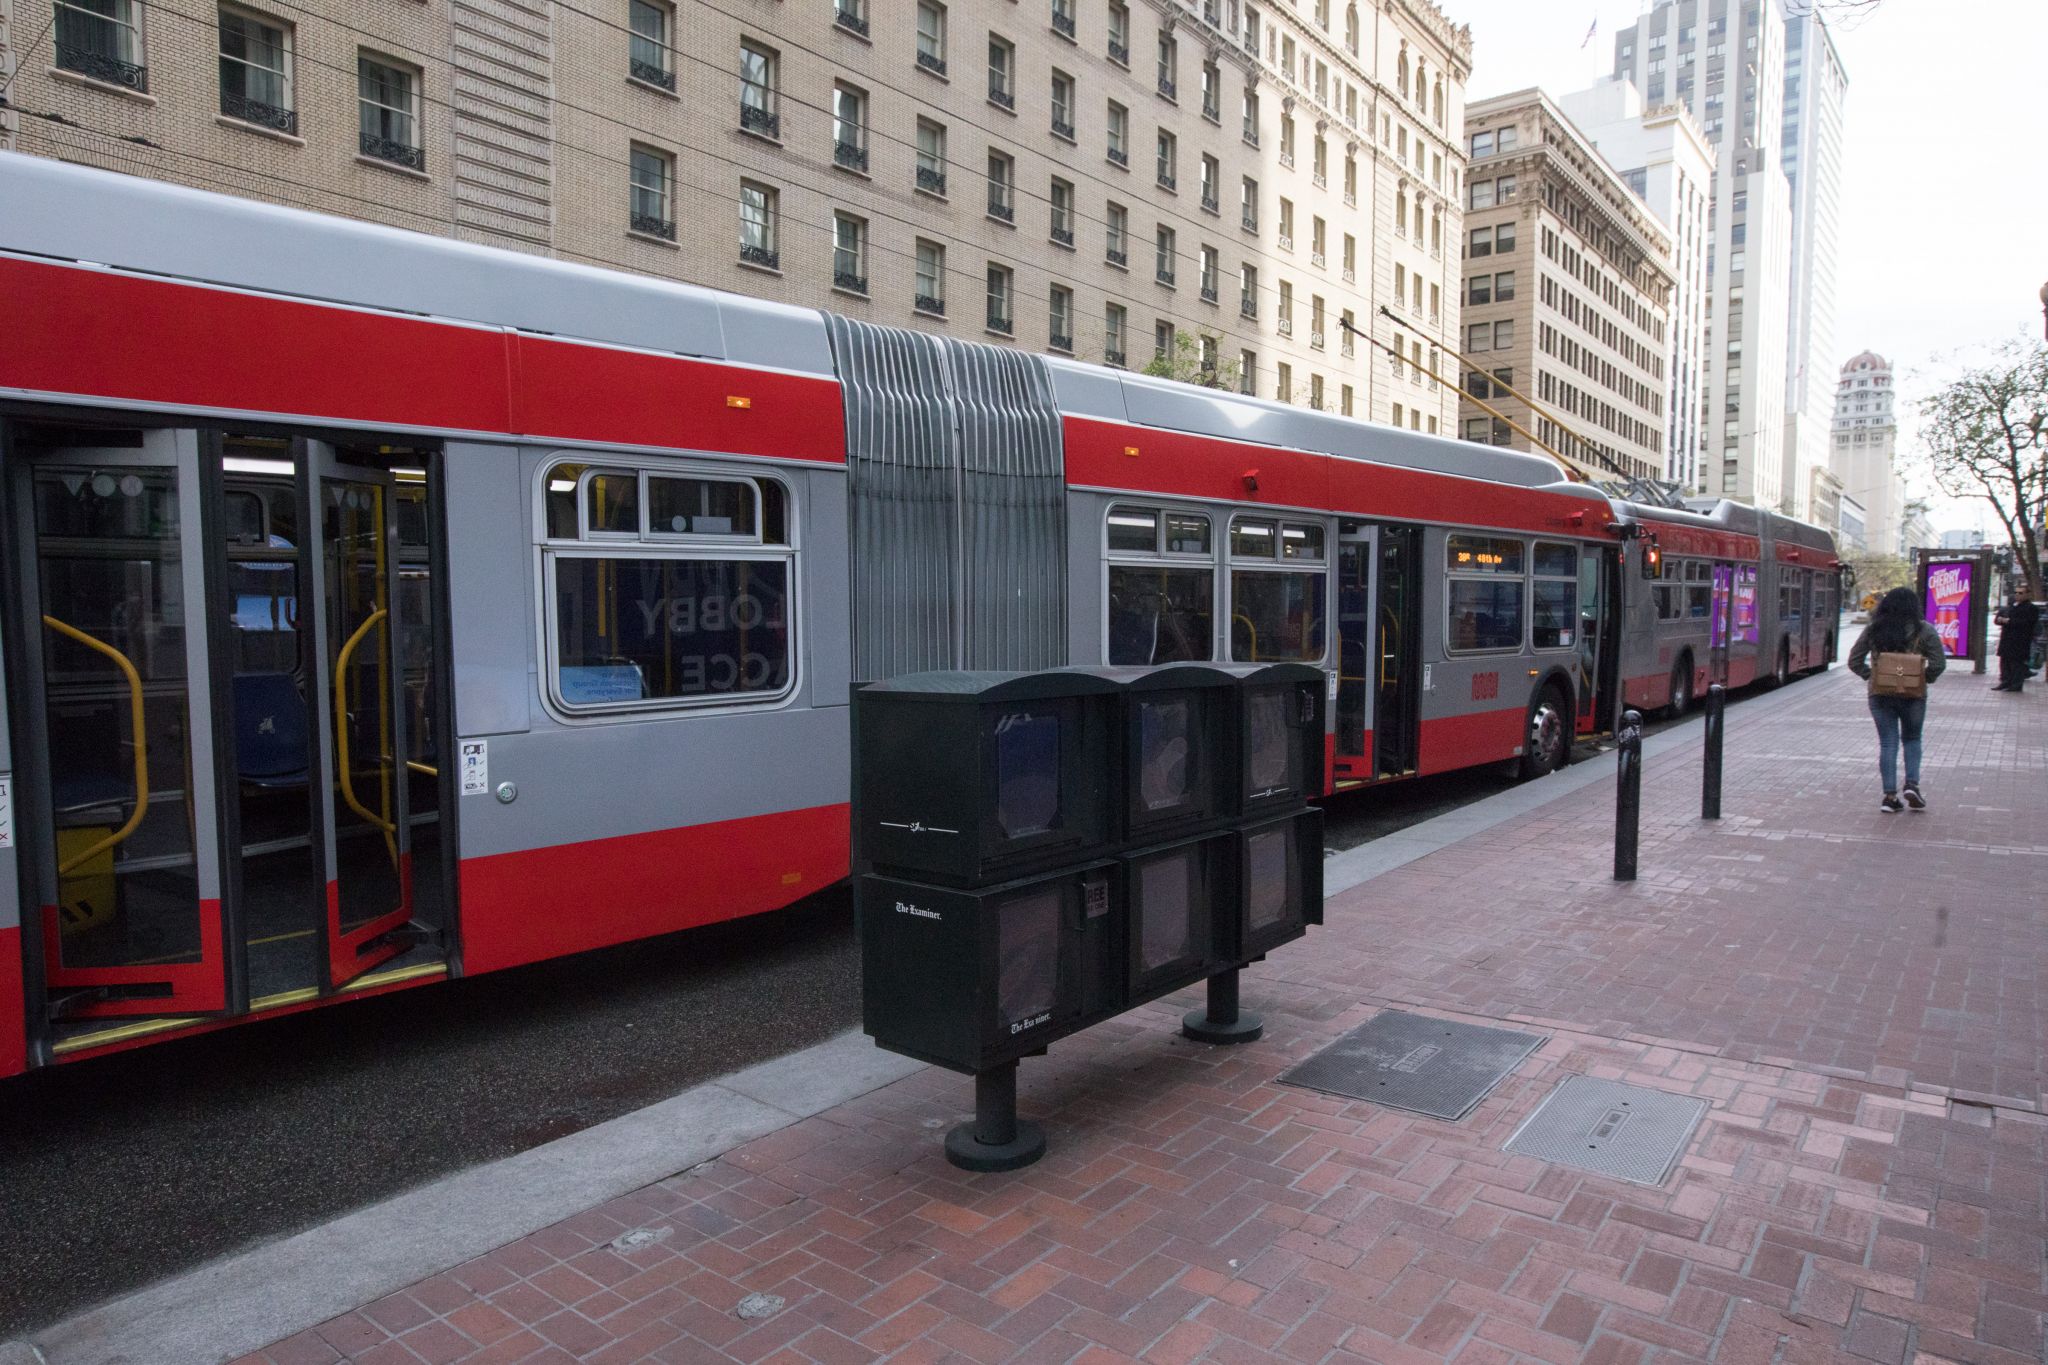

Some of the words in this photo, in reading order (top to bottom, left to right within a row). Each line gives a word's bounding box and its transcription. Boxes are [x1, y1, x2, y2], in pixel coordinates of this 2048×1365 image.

[1928, 567, 1960, 588] CHERRY
[1935, 579, 1969, 598] VANILLA
[1087, 886, 1105, 904] REE
[895, 901, 909, 913] The
[909, 904, 942, 920] Examiner.
[1011, 1022, 1023, 1034] The
